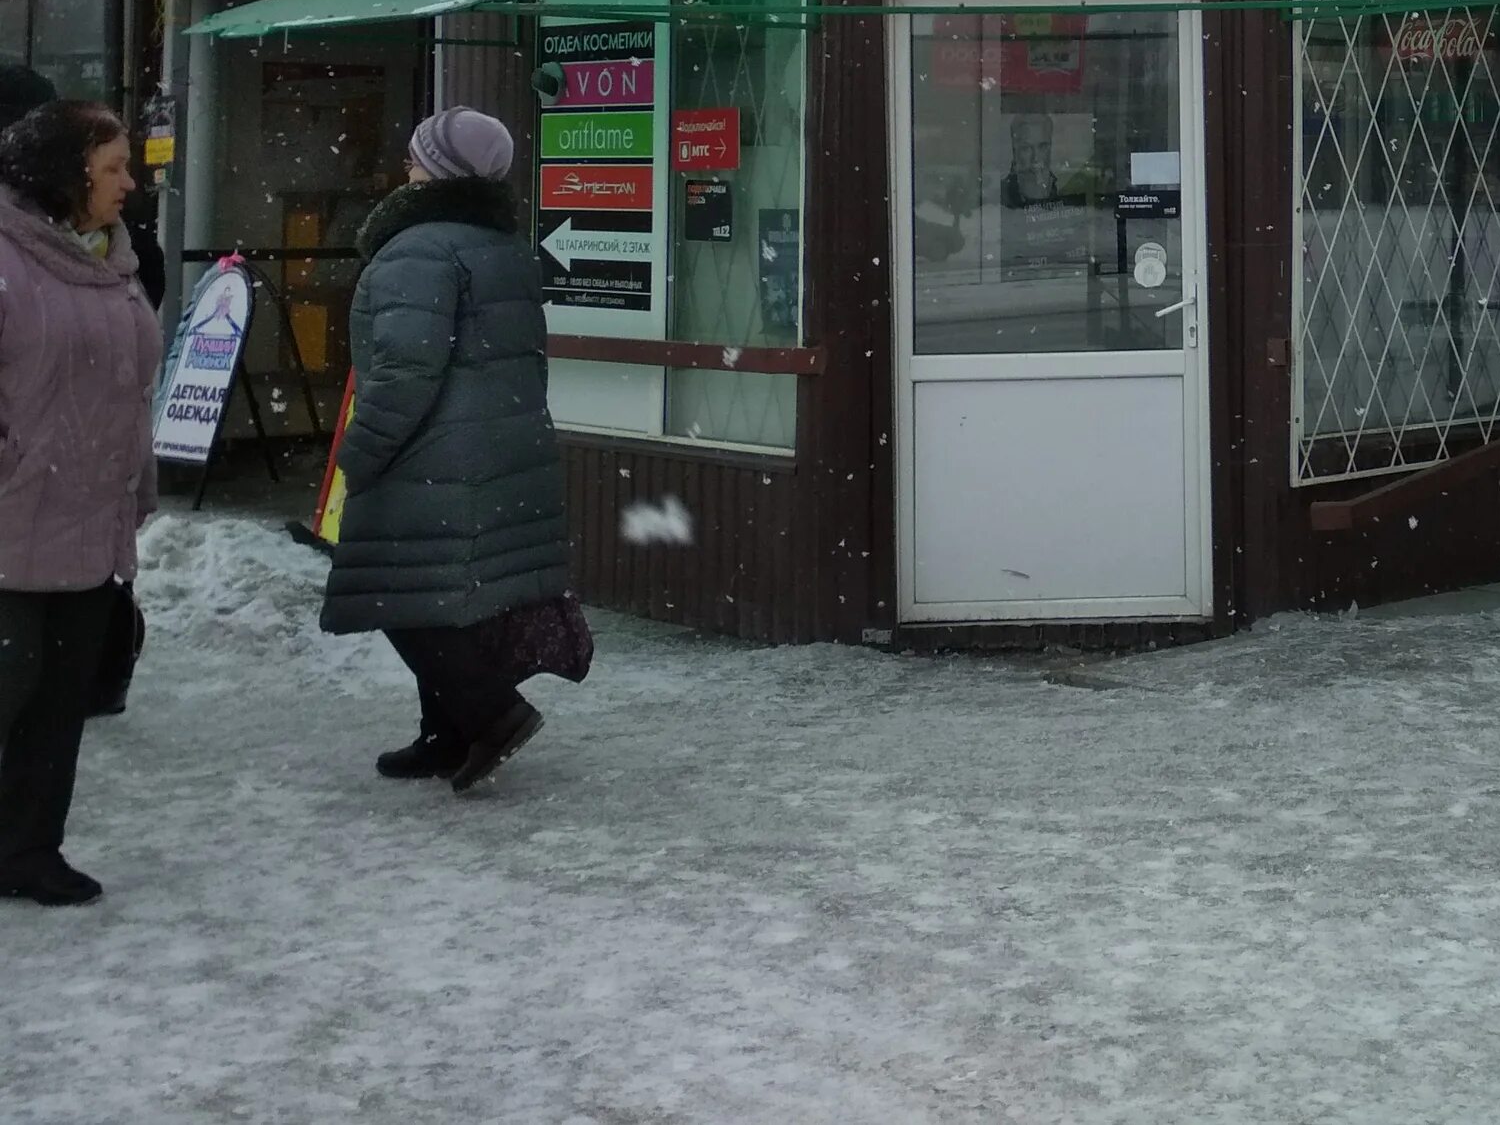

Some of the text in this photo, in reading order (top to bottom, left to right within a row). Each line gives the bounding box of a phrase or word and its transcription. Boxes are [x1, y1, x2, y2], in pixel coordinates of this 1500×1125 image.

[544, 31, 653, 54] ОТДЕЛ КОСМЕТИКИ
[565, 68, 636, 98] VON
[559, 120, 634, 150] oriflame
[691, 144, 710, 157] МТС
[629, 242, 651, 253] ЭТАЖ
[171, 383, 226, 404] ДЕТСКАЯ
[166, 402, 219, 425] ОДЕЖДА
